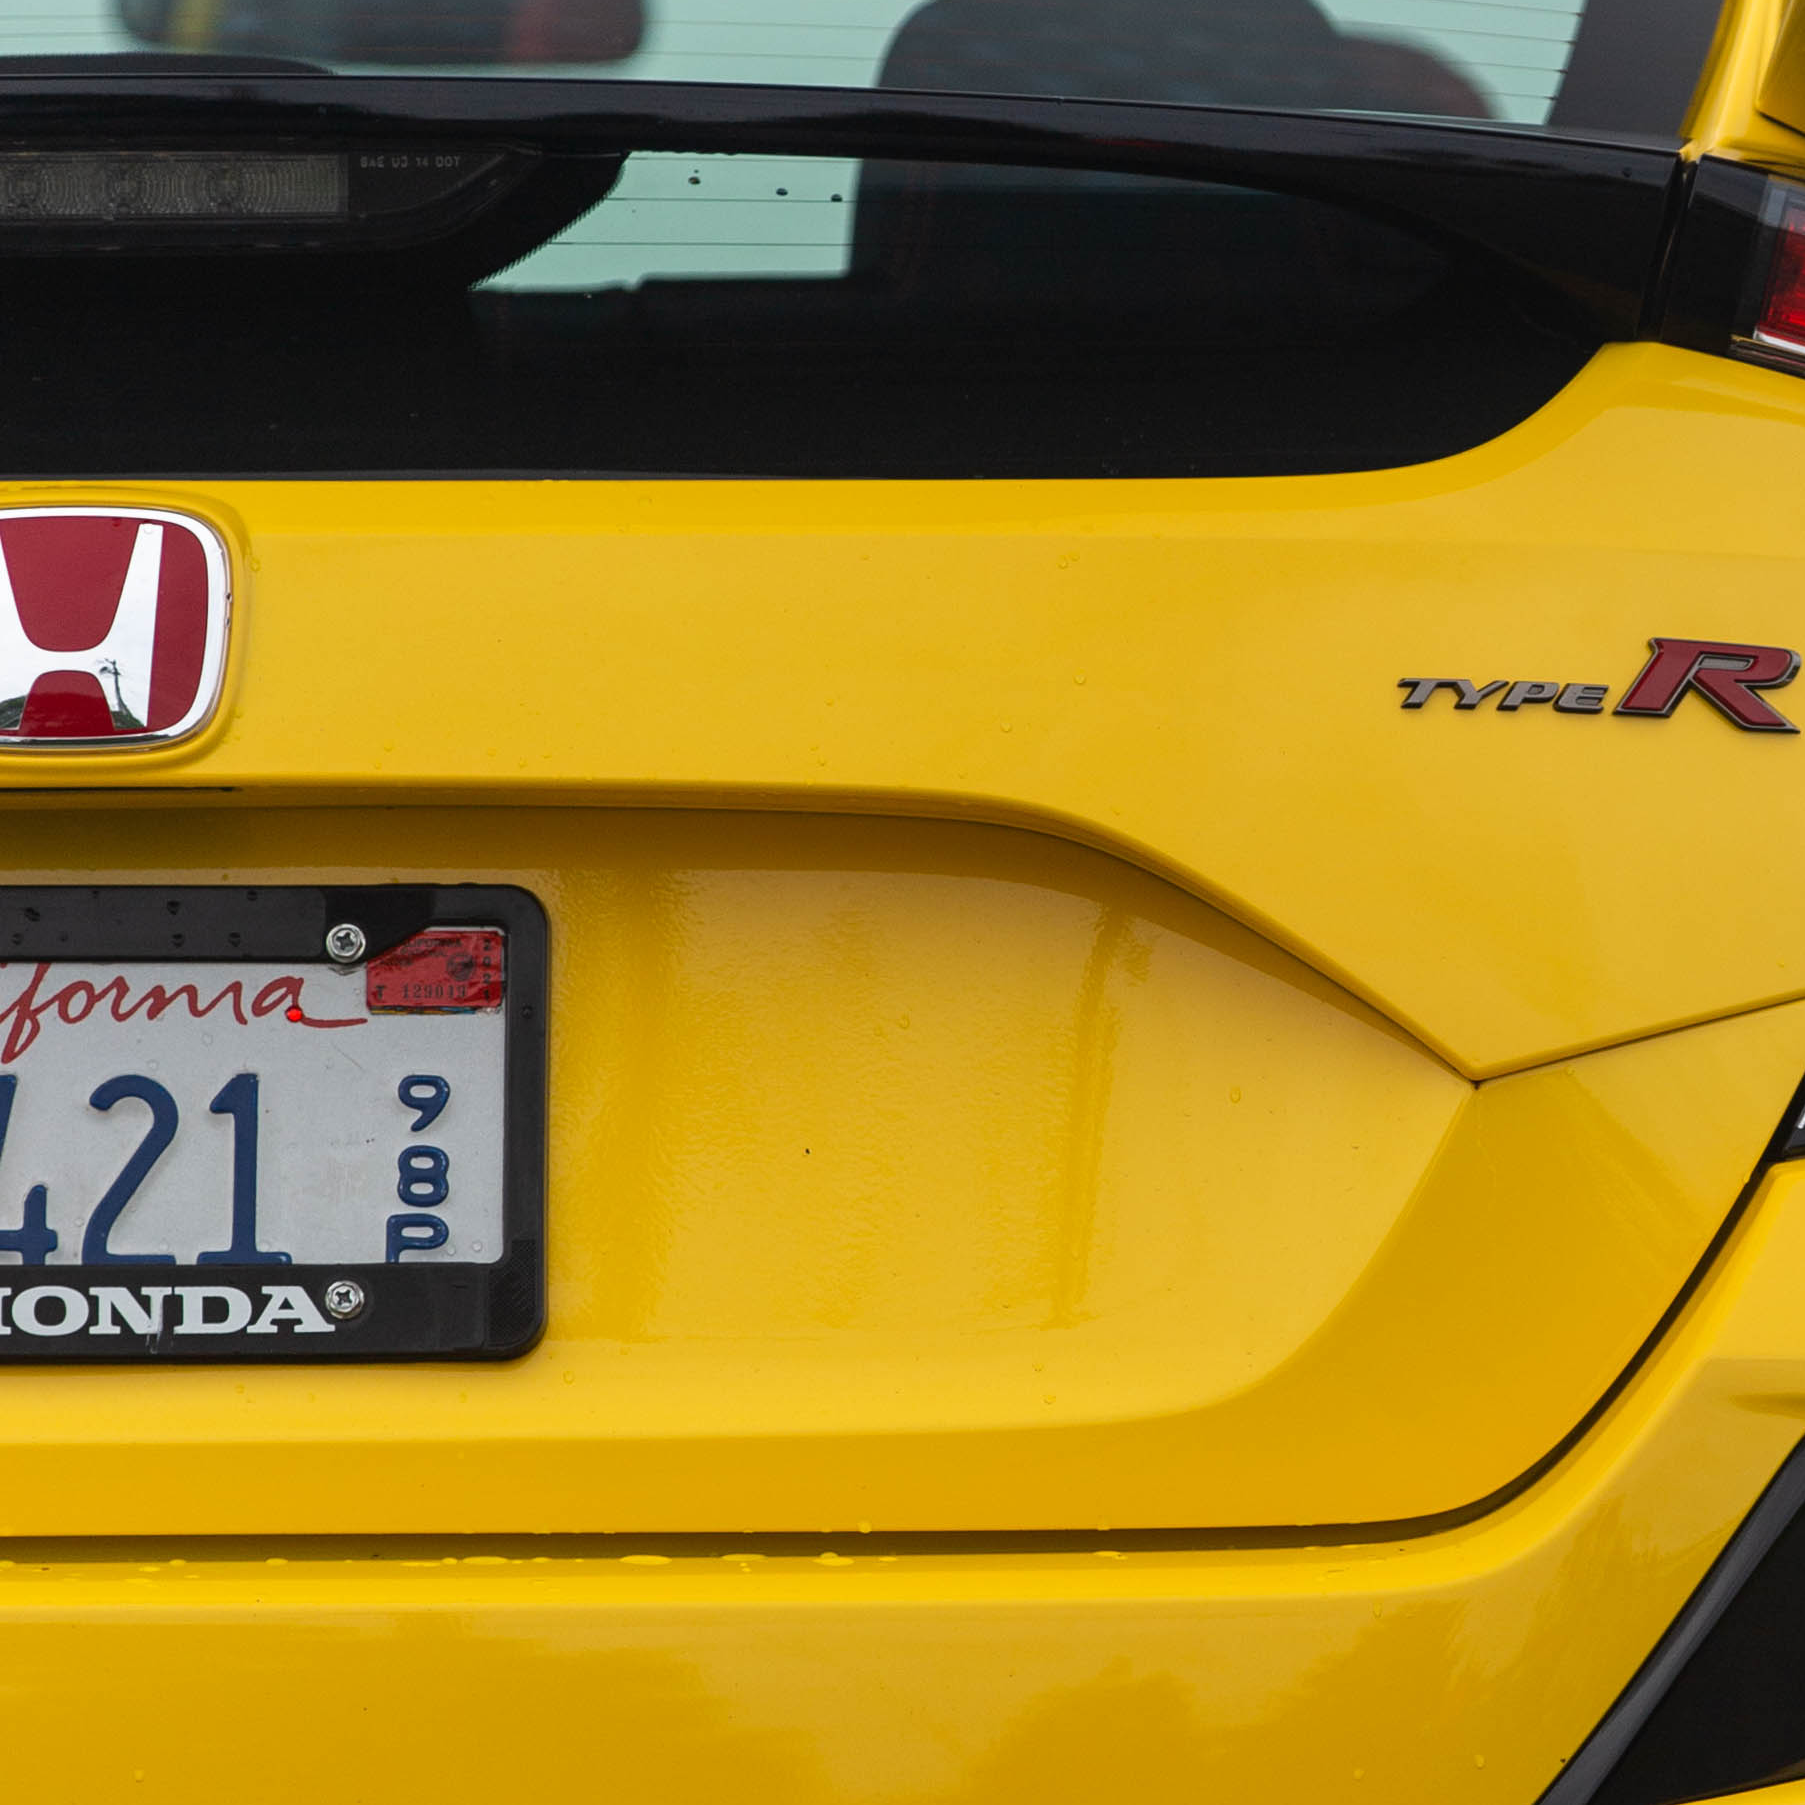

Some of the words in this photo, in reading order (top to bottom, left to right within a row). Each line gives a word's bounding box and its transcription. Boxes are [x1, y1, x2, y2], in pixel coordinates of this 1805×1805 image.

[360, 155, 385, 168] SAE
[435, 155, 461, 168] DOT
[1398, 678, 1610, 713] TYPE
[1612, 637, 1801, 735] R
[0, 1285, 336, 1336] ONDA
